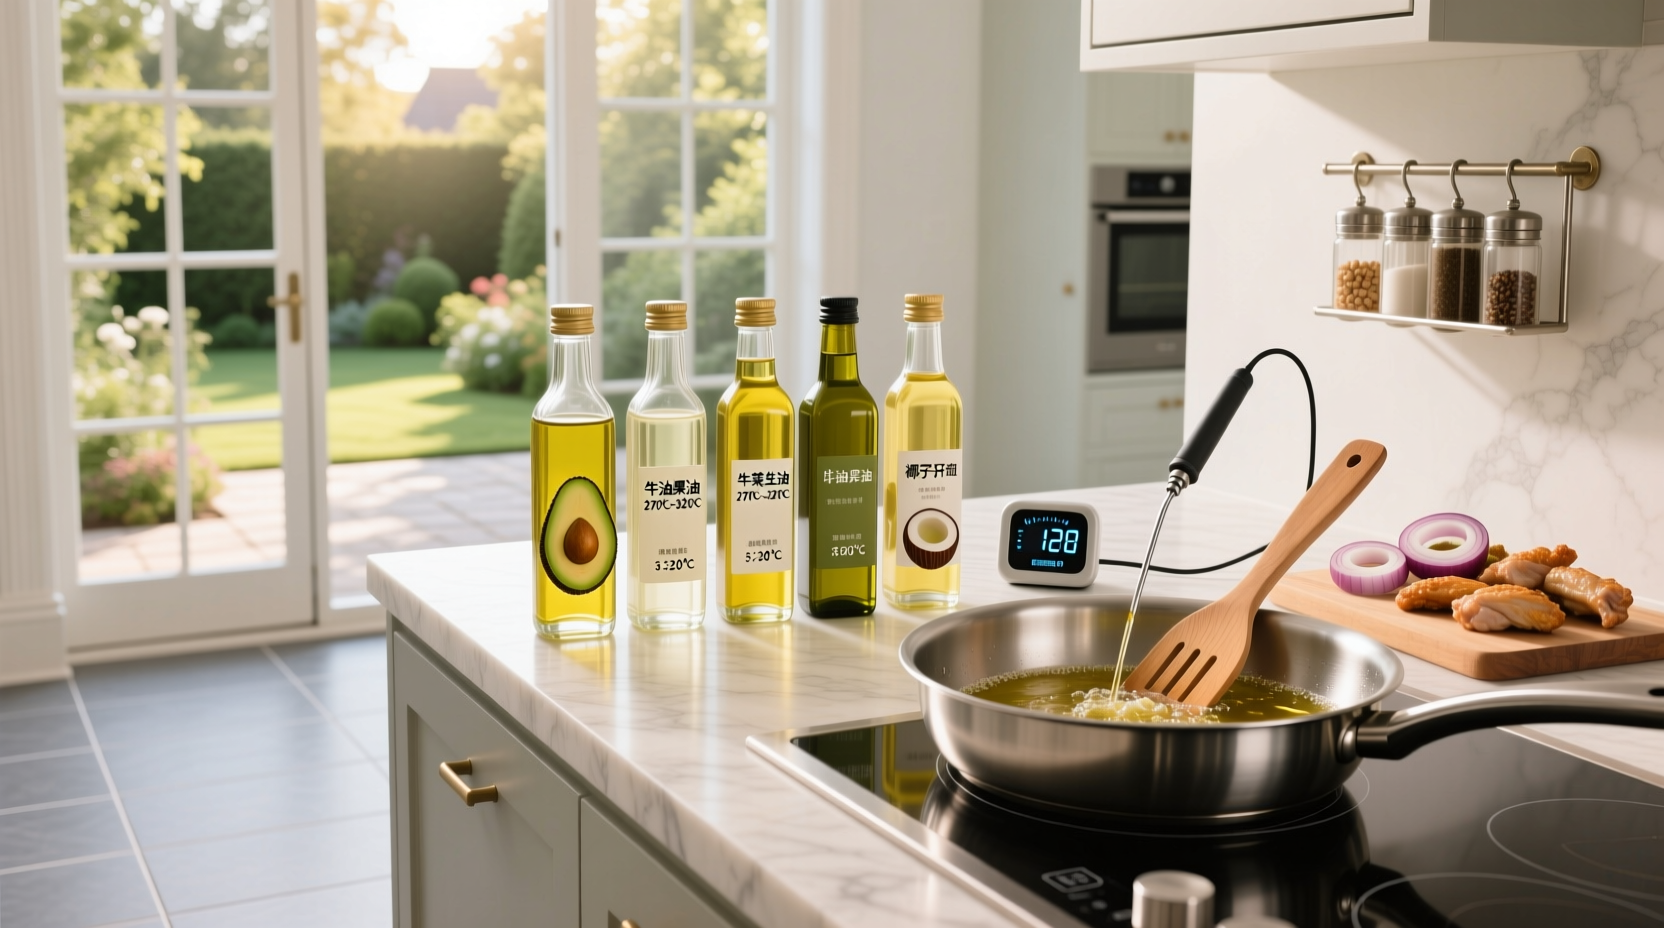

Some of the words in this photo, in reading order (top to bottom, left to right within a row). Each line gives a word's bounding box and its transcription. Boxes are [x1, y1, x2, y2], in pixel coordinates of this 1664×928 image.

[644, 479, 701, 496] 牛油果油
[1042, 528, 1079, 554] 128
